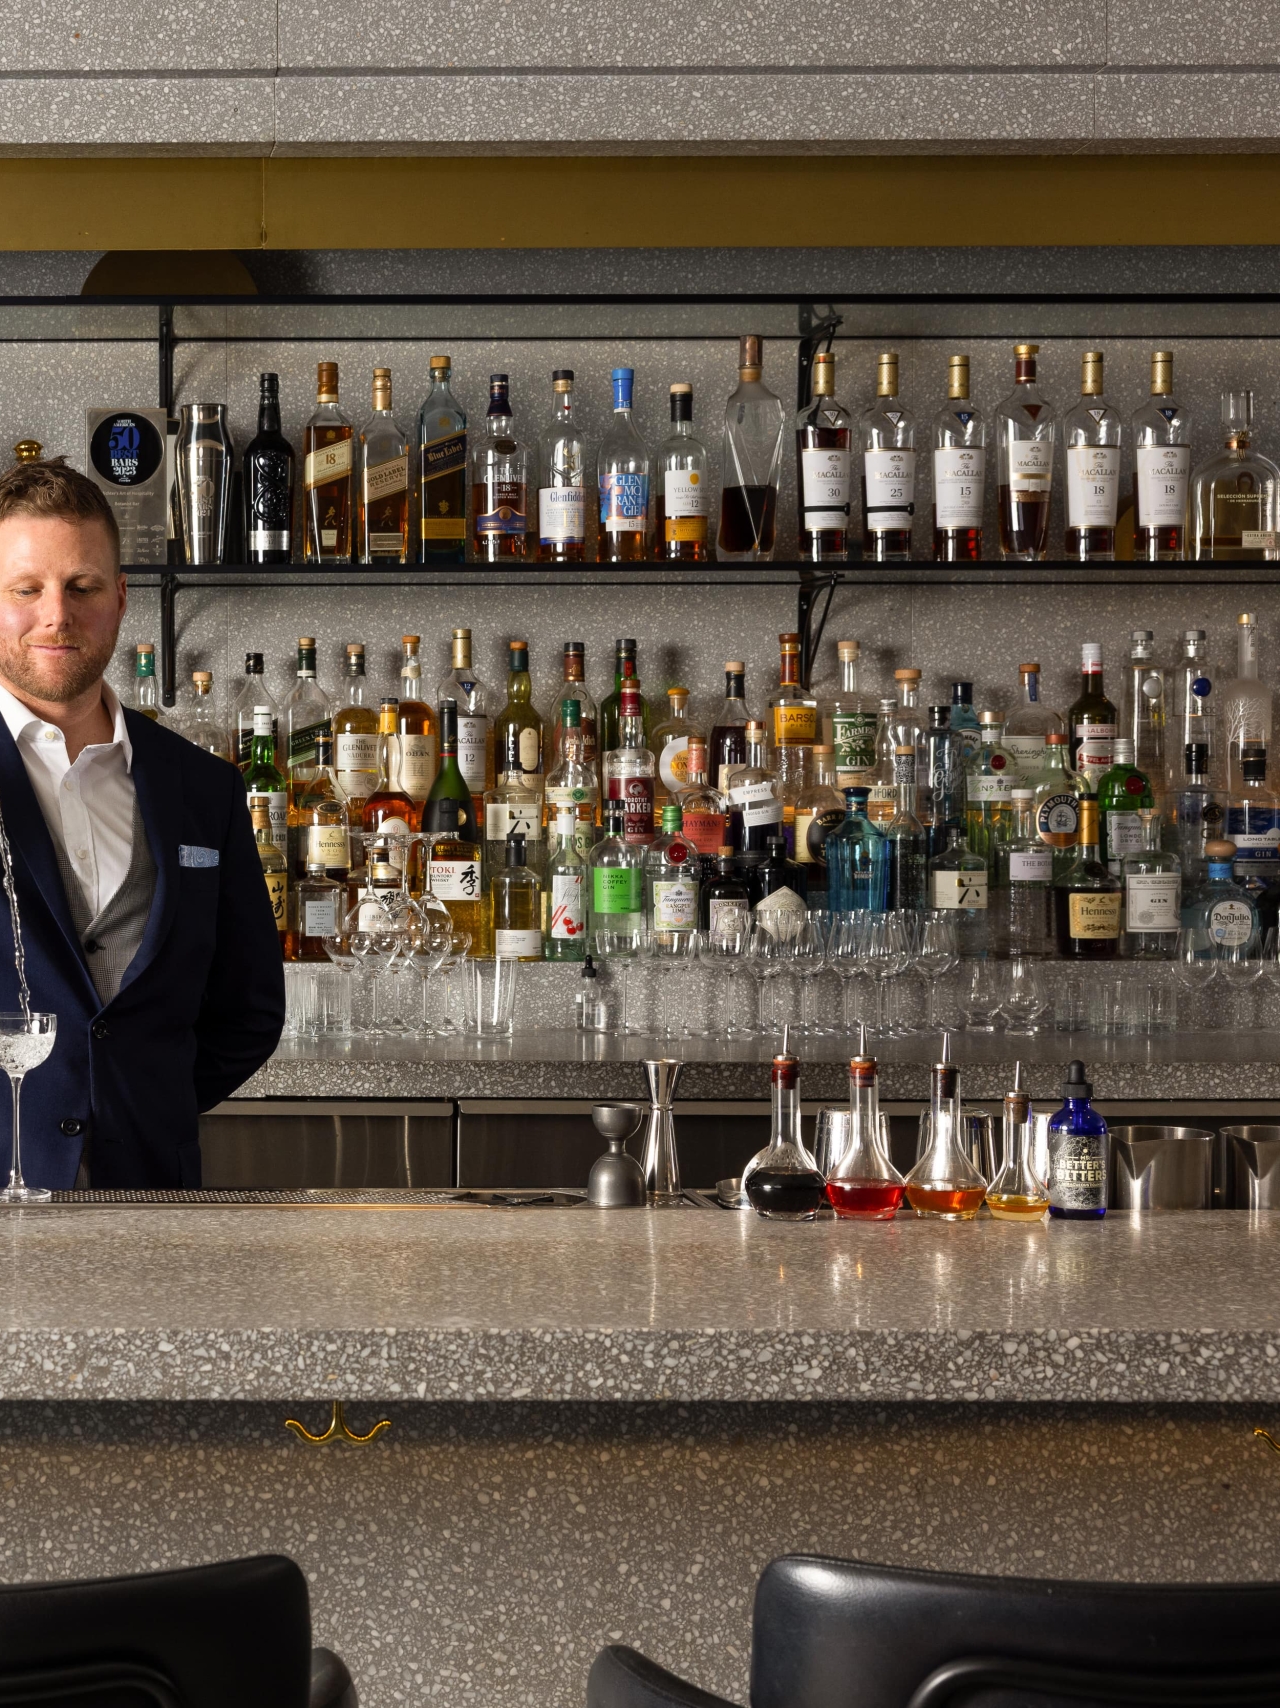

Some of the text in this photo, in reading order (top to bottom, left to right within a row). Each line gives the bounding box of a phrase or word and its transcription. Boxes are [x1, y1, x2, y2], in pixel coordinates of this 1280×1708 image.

[623, 400, 630, 408] 15
[108, 427, 140, 450] 50
[110, 450, 139, 459] BEST
[427, 443, 463, 462] Blue Label
[326, 453, 336, 464] 18
[113, 467, 136, 475] 2023
[383, 466, 406, 478] LABEL
[615, 475, 641, 486] GLEN
[827, 488, 841, 497] 30
[890, 488, 903, 498] 25
[960, 487, 972, 496] 15
[1093, 486, 1105, 495] 18
[1164, 485, 1175, 494] 18
[615, 496, 636, 506] RAN
[691, 500, 699, 508] 12
[623, 505, 640, 516] GIE
[628, 520, 635, 528] 15
[1011, 745, 1046, 759] Sheringh
[465, 754, 475, 762] 12
[846, 756, 870, 766] GIN
[742, 788, 768, 796] EMPRESS
[625, 803, 651, 813] ARKER
[1040, 796, 1077, 822] PLYMOUTH
[316, 841, 346, 849] Hennessy
[662, 895, 694, 903] Tanqueray
[1214, 913, 1231, 922] Don
[1060, 1161, 1105, 1170] BETTER'S
[1057, 1170, 1107, 1181] BITTERS
